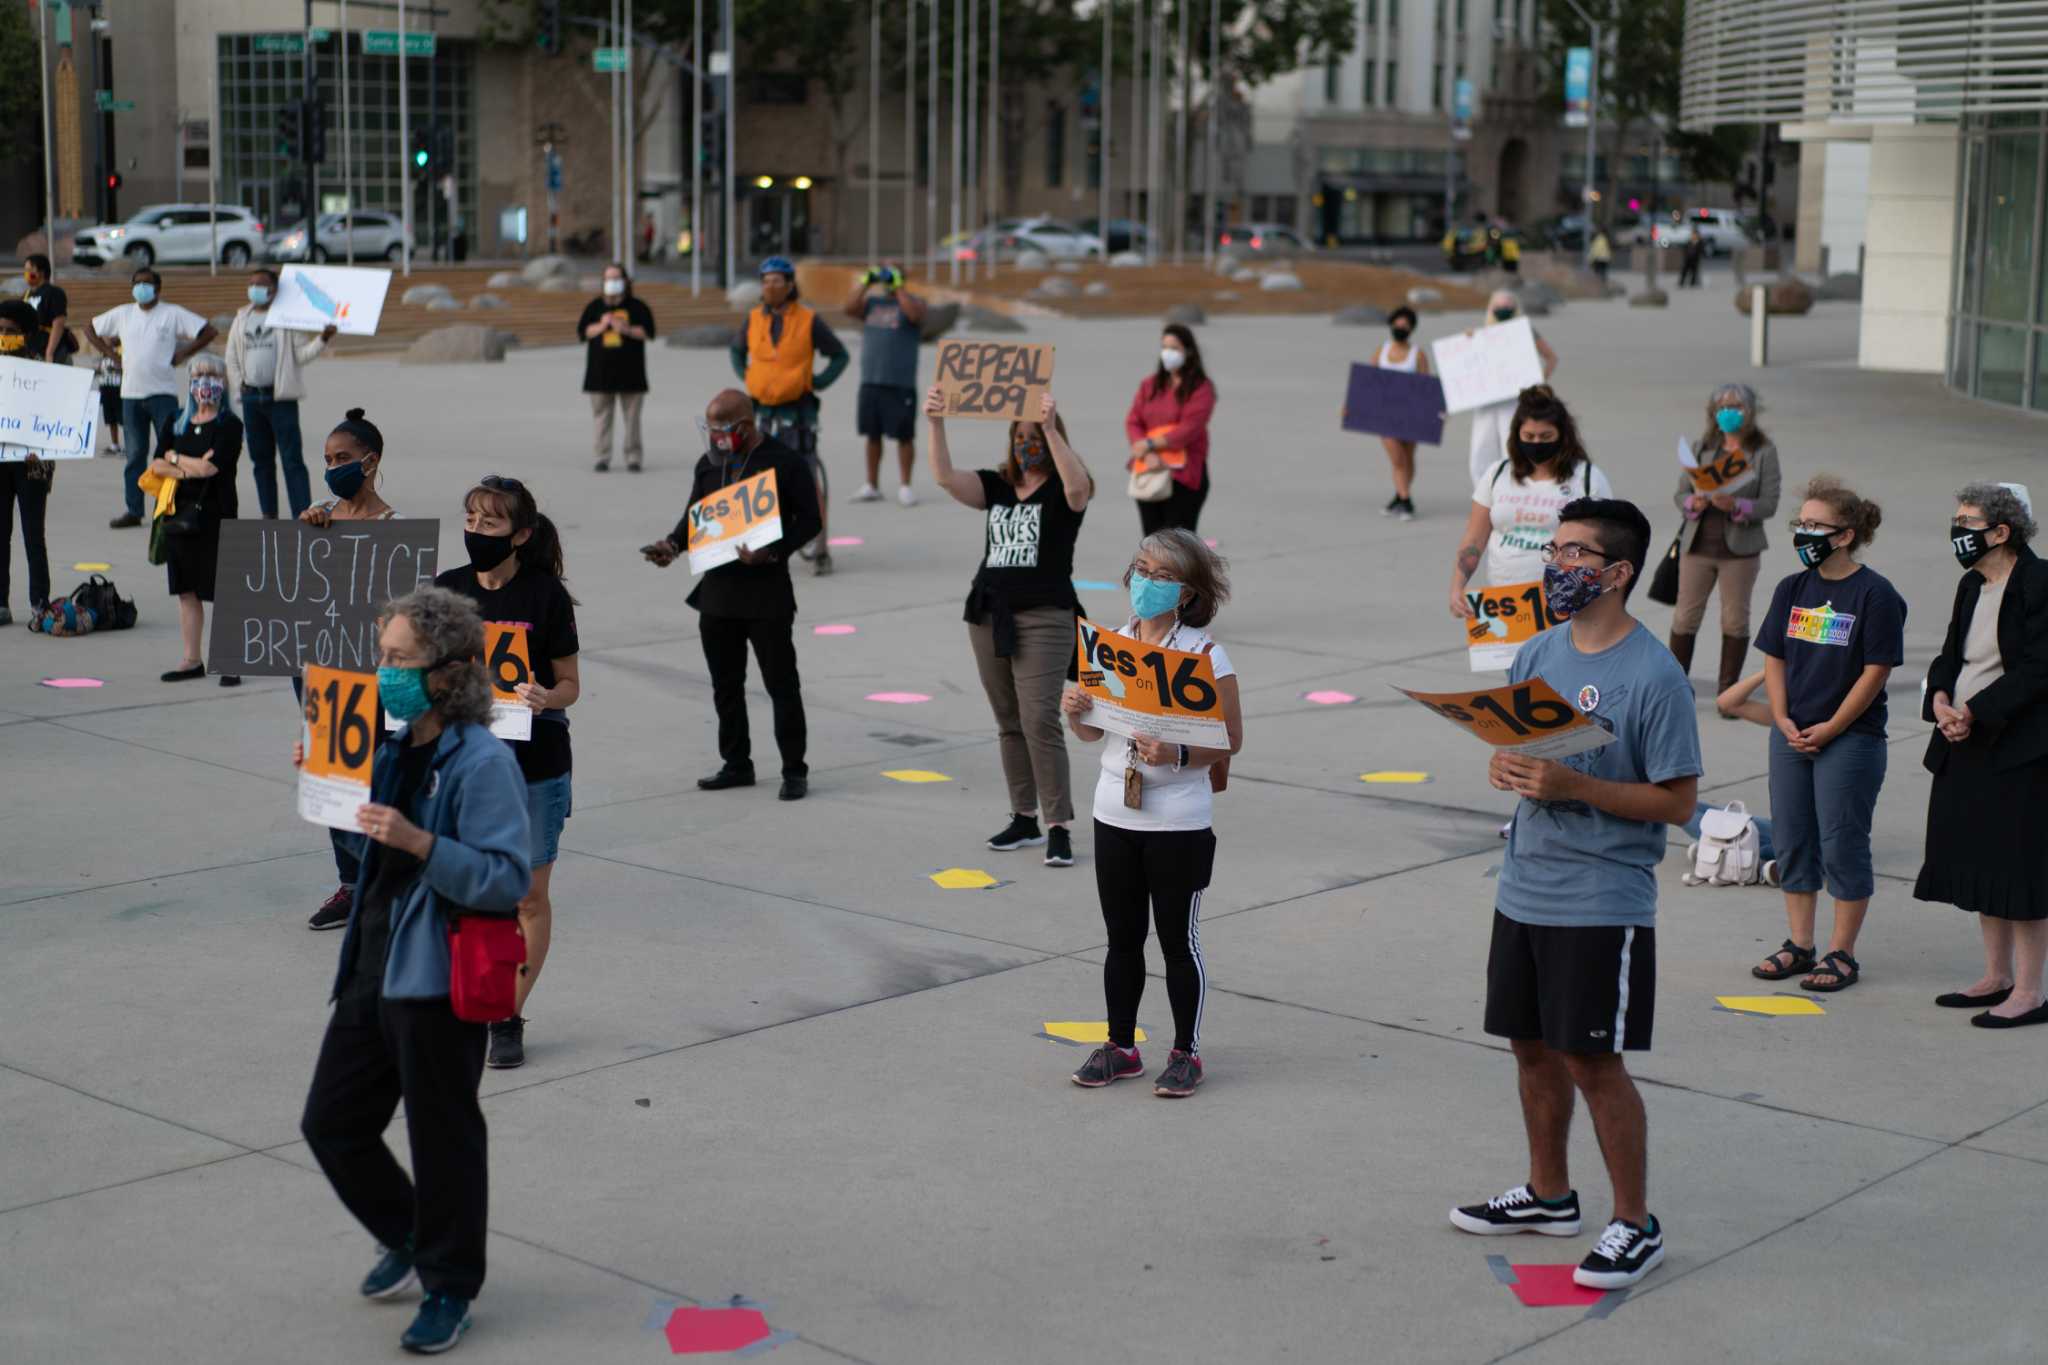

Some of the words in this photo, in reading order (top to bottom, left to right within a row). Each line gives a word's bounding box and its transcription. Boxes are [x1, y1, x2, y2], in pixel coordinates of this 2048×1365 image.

[12, 369, 41, 391] her
[937, 343, 1049, 385] REPEAL
[959, 382, 1027, 416] 209
[30, 412, 73, 440] Taylor
[690, 498, 730, 528] Yes
[732, 476, 775, 524] 16
[990, 503, 1042, 523] BLACK
[990, 520, 1038, 545] LIVES
[246, 529, 435, 606] JUSTICE
[986, 544, 1038, 567] MATTER
[324, 600, 341, 628] 4
[1466, 592, 1518, 619] Yes
[1516, 612, 1531, 623] on
[485, 632, 529, 693] 6
[1080, 625, 1138, 677] Yes
[1136, 678, 1153, 691] on
[1141, 651, 1217, 711] 16
[324, 679, 370, 770] 16
[1469, 686, 1575, 736] 16
[1478, 718, 1502, 729] on
